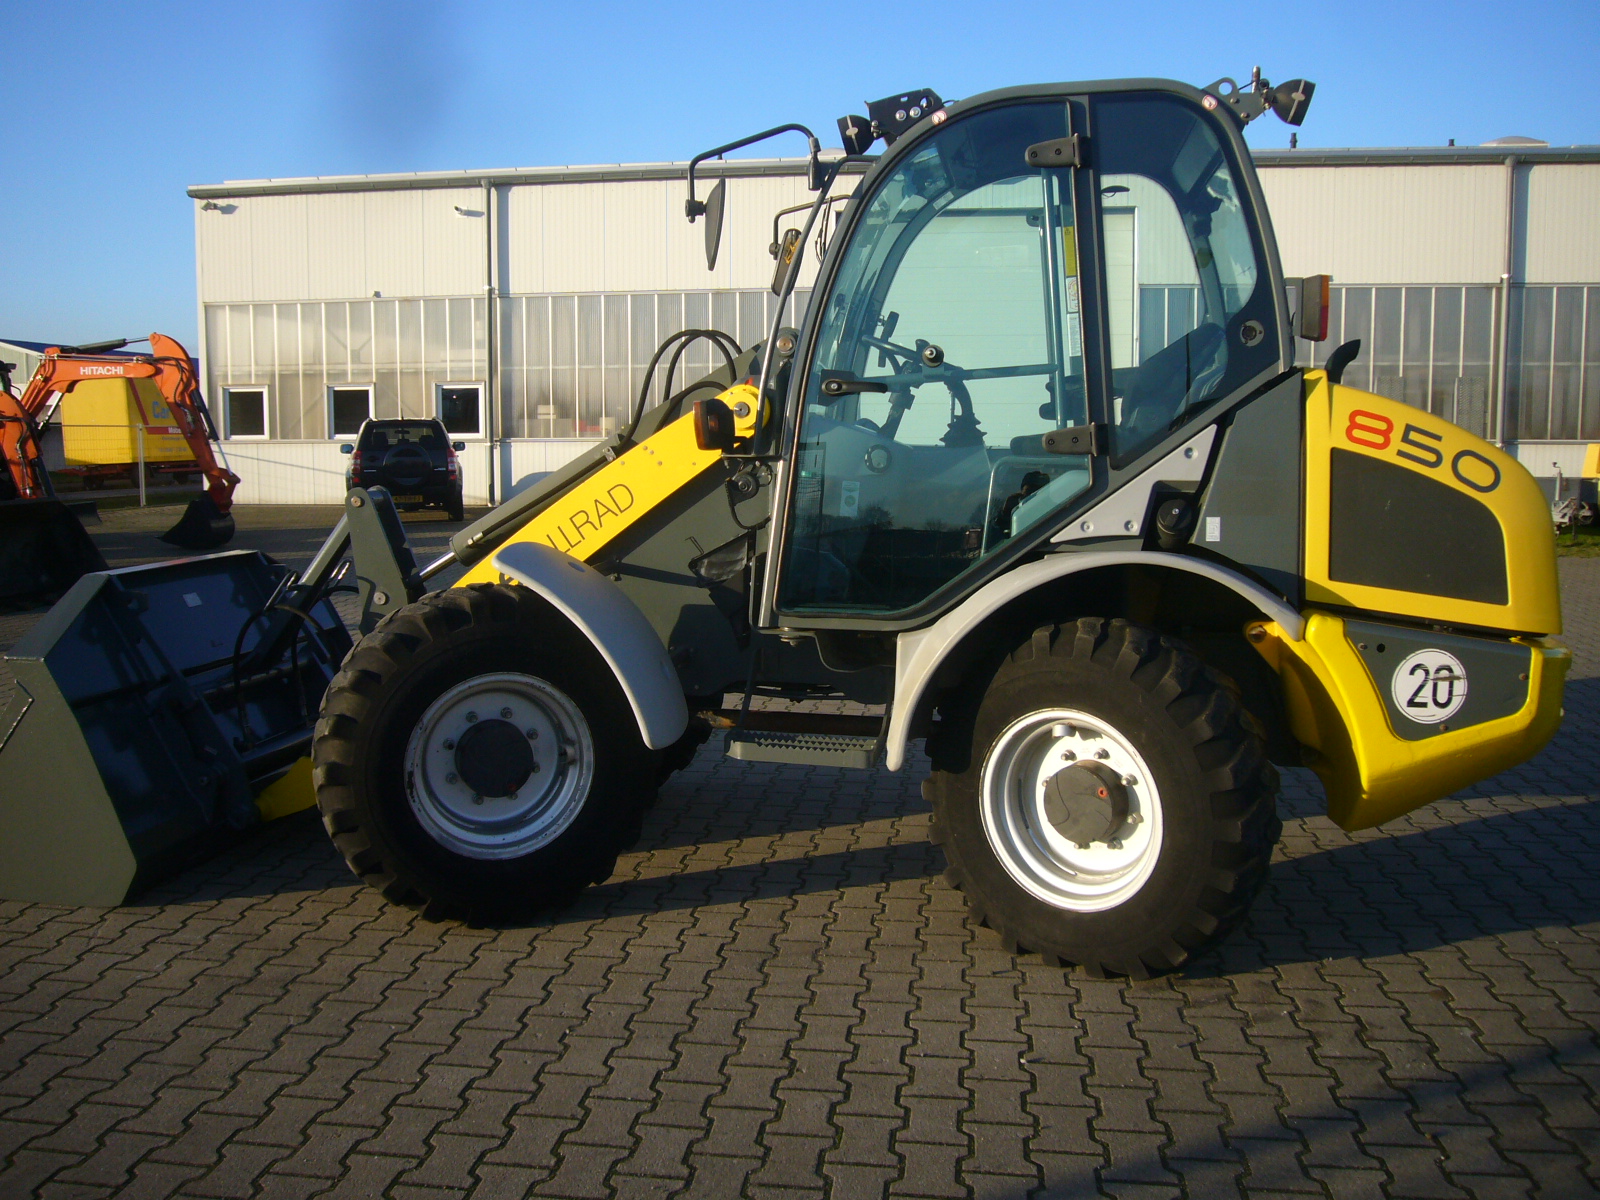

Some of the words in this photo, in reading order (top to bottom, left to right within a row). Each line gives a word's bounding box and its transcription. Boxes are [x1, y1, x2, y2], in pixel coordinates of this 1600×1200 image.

[80, 366, 124, 375] HITACHI
[1345, 409, 1502, 494] 850
[1406, 663, 1455, 709] 20
